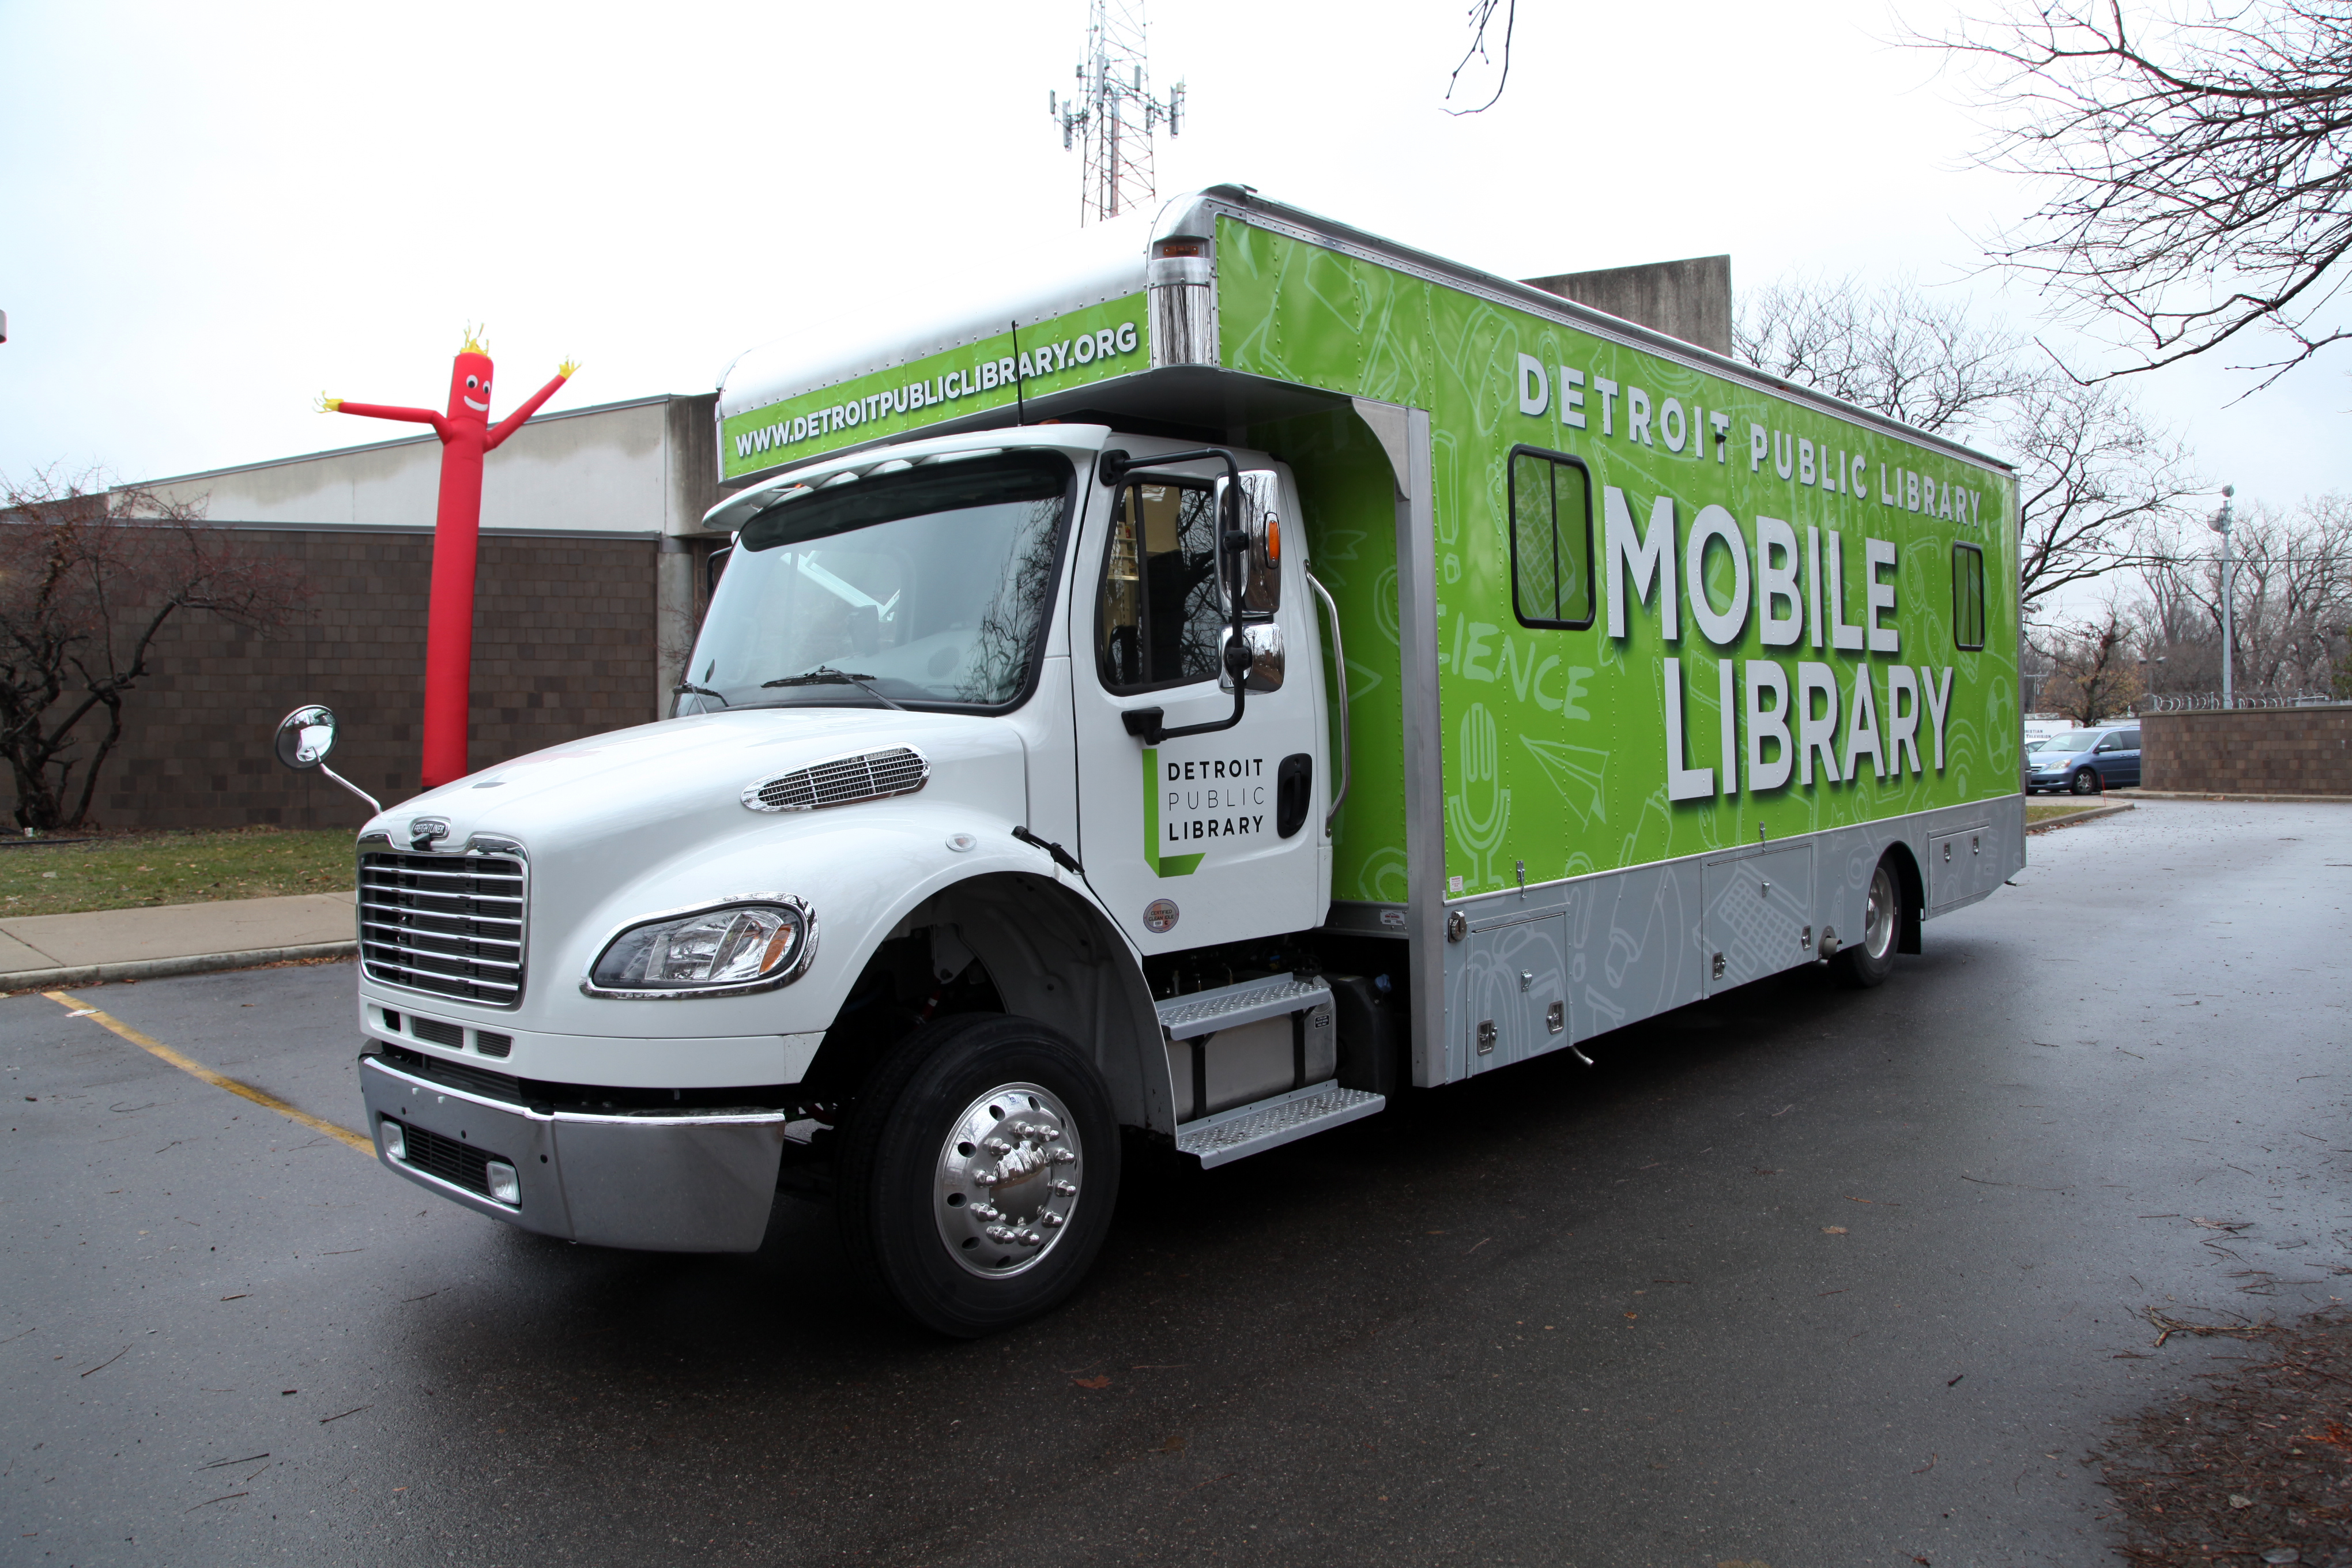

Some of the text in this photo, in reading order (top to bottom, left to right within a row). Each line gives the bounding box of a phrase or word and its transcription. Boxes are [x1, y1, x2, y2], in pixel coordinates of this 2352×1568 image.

[735, 322, 1137, 457] WWW.DETROITPUBLICLIBRARY.ORG
[1518, 352, 1981, 527] DETROIT PUBLIC LIBRARY
[1604, 485, 1899, 653] MOBILE
[1664, 657, 1953, 801] LIBRARY
[1168, 759, 1263, 781] DETROIT
[1169, 786, 1264, 811] PUBLIC
[414, 823, 445, 834] FREIGHTLINER
[1169, 815, 1264, 841] LIBRARY
